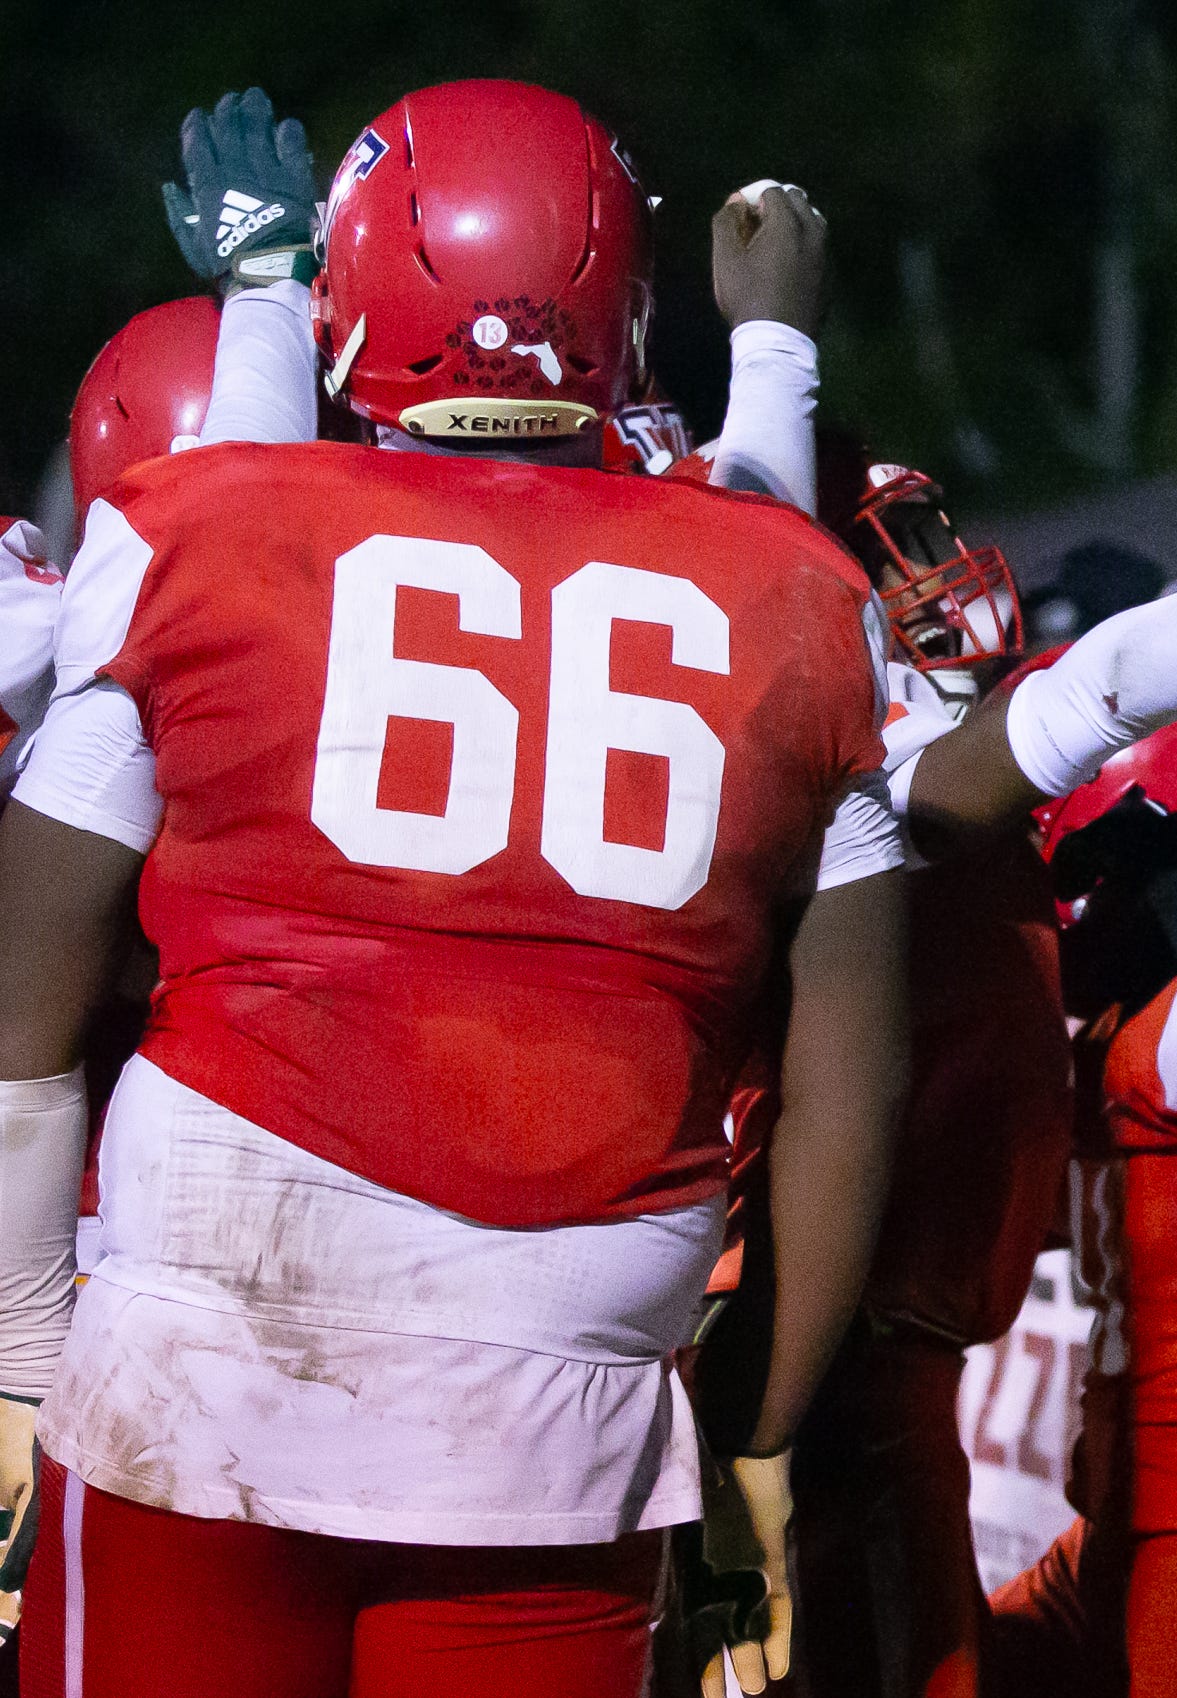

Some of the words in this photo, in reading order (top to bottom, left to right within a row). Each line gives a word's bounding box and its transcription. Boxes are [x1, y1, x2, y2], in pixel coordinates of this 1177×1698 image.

[217, 203, 286, 257] adidas
[478, 322, 503, 345] 13
[447, 412, 558, 434] XENITH
[310, 533, 730, 911] 66
